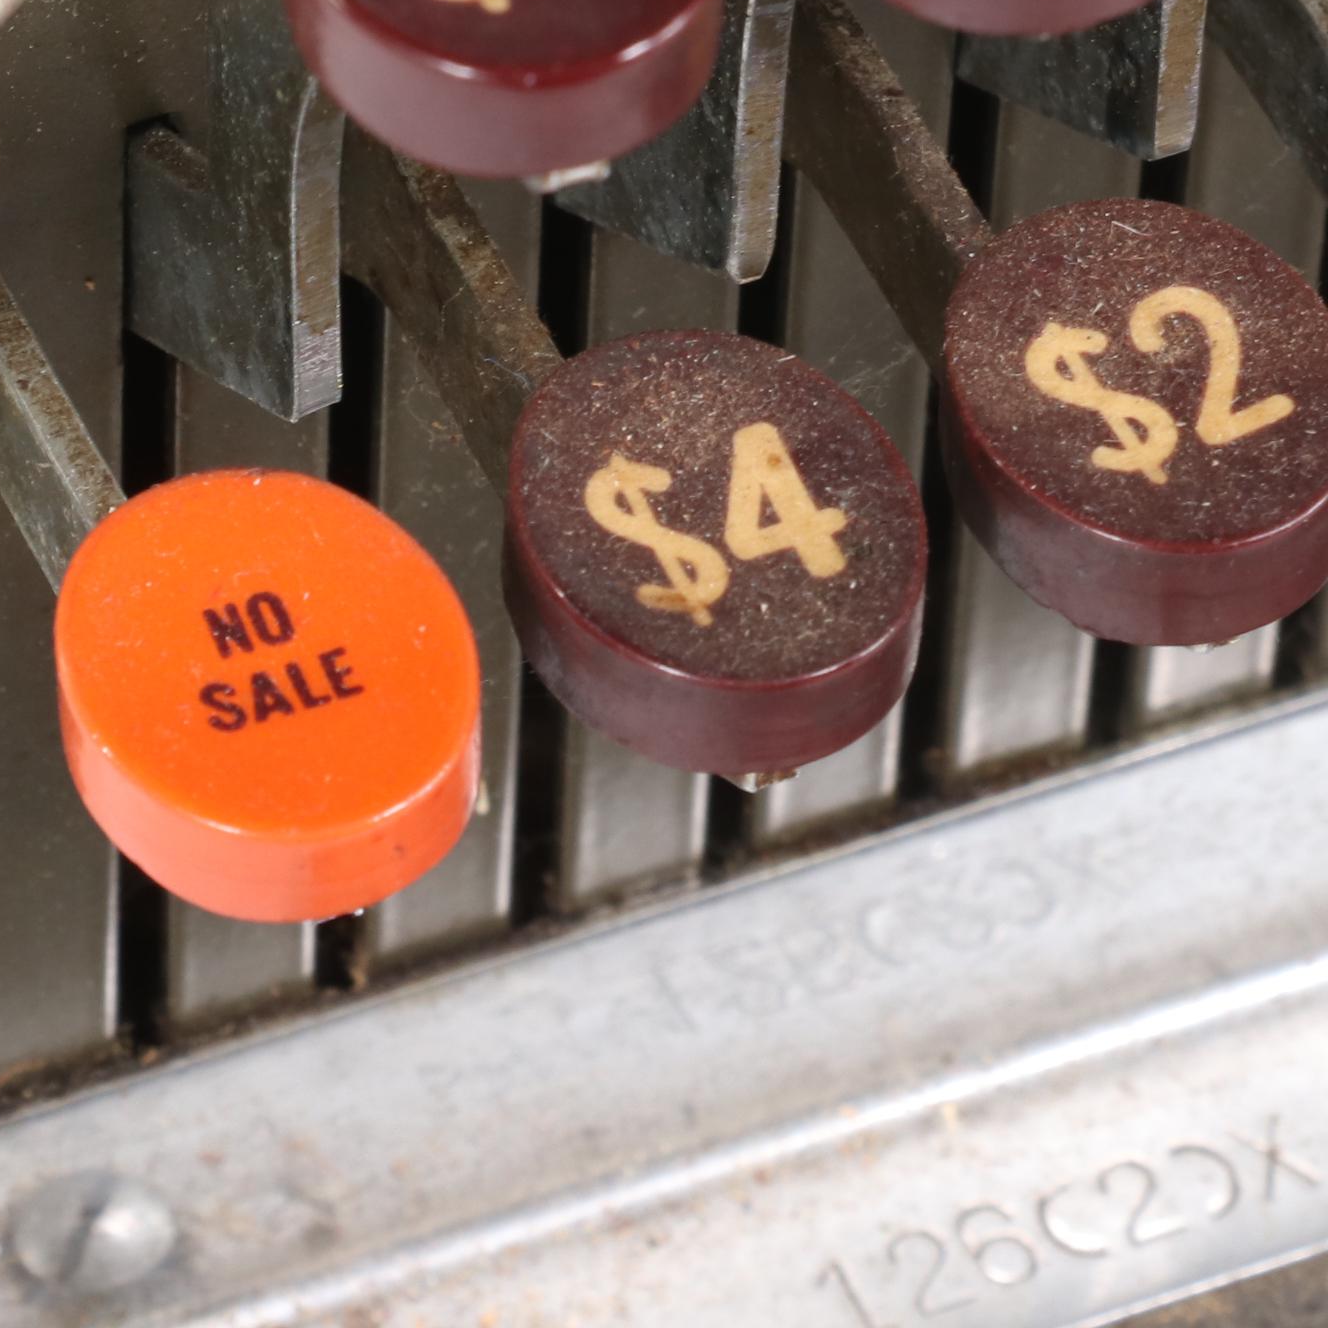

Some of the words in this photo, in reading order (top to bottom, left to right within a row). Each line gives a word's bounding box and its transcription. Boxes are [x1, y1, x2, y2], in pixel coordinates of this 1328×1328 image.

[1024, 284, 1295, 485] $2
[583, 421, 849, 627] $4
[198, 647, 365, 733] SALE
[202, 591, 297, 660] NO
